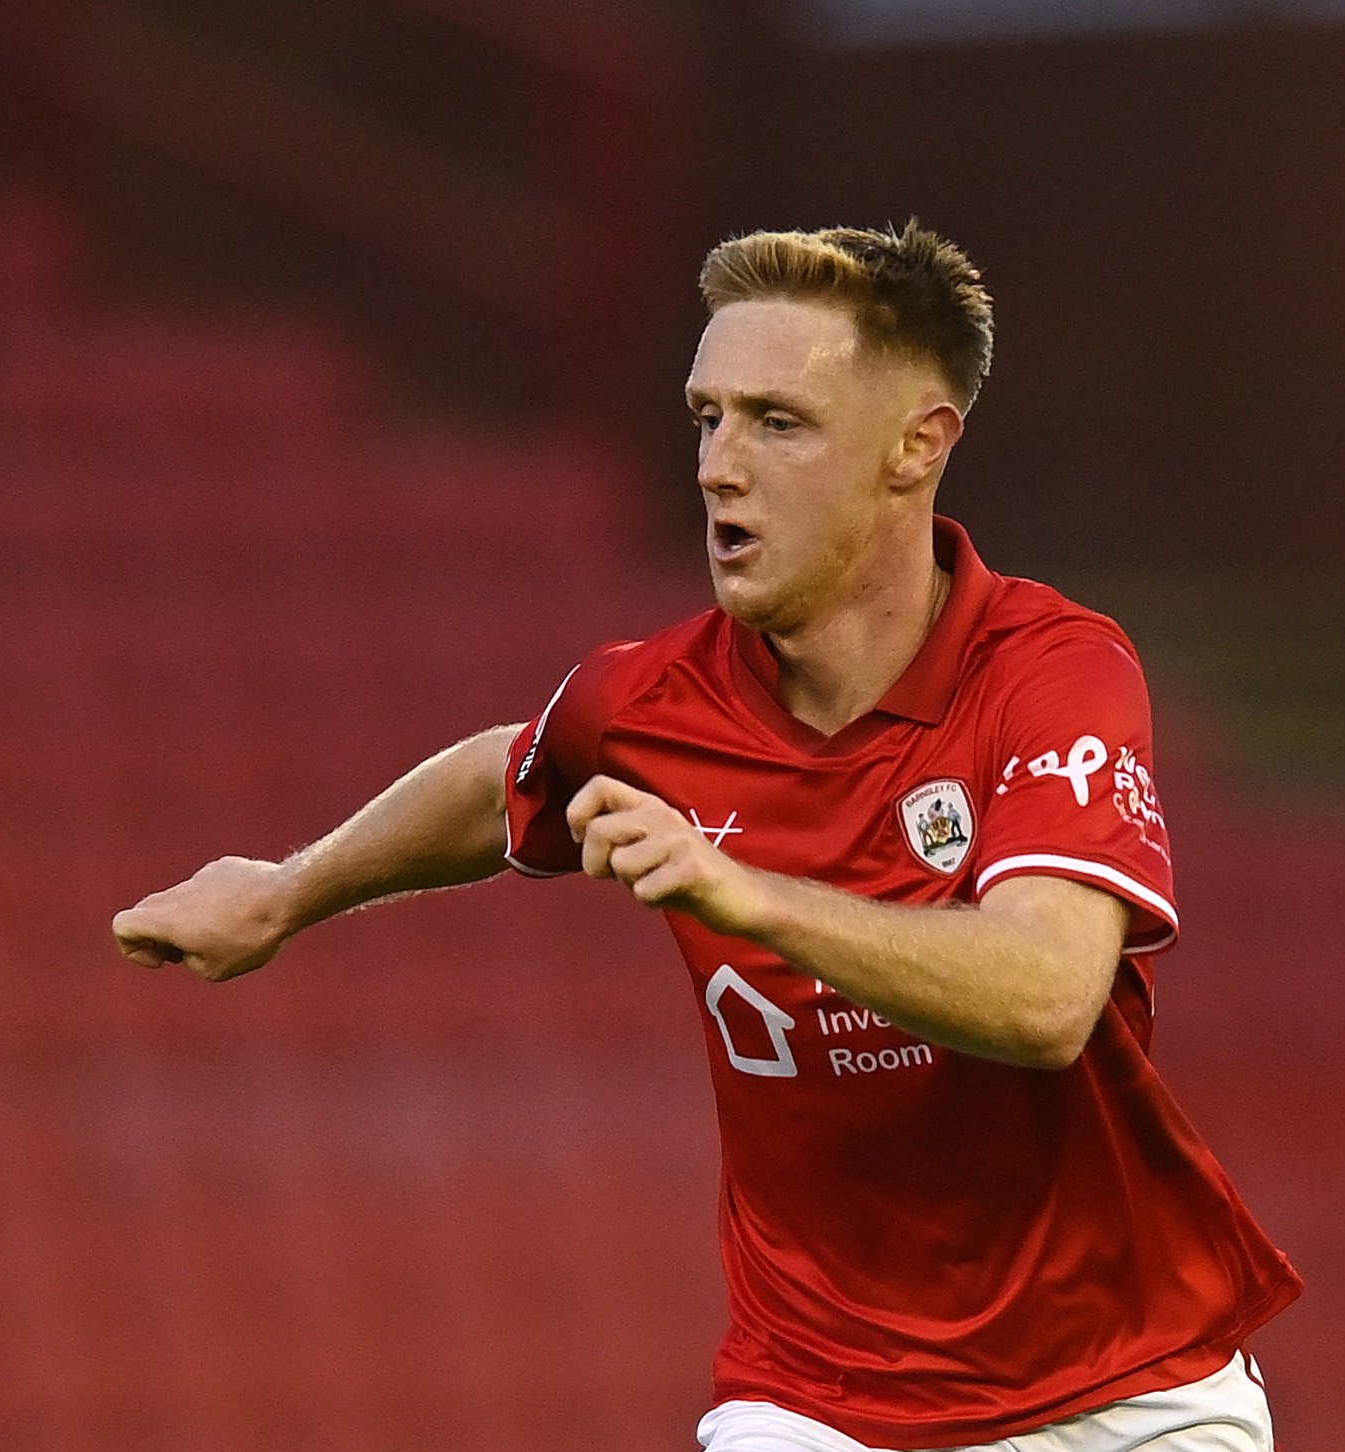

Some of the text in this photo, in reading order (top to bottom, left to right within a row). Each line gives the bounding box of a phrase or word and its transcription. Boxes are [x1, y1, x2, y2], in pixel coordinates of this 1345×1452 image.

[905, 784, 957, 808] BARNSLEY FC
[829, 1043, 933, 1077] Room
